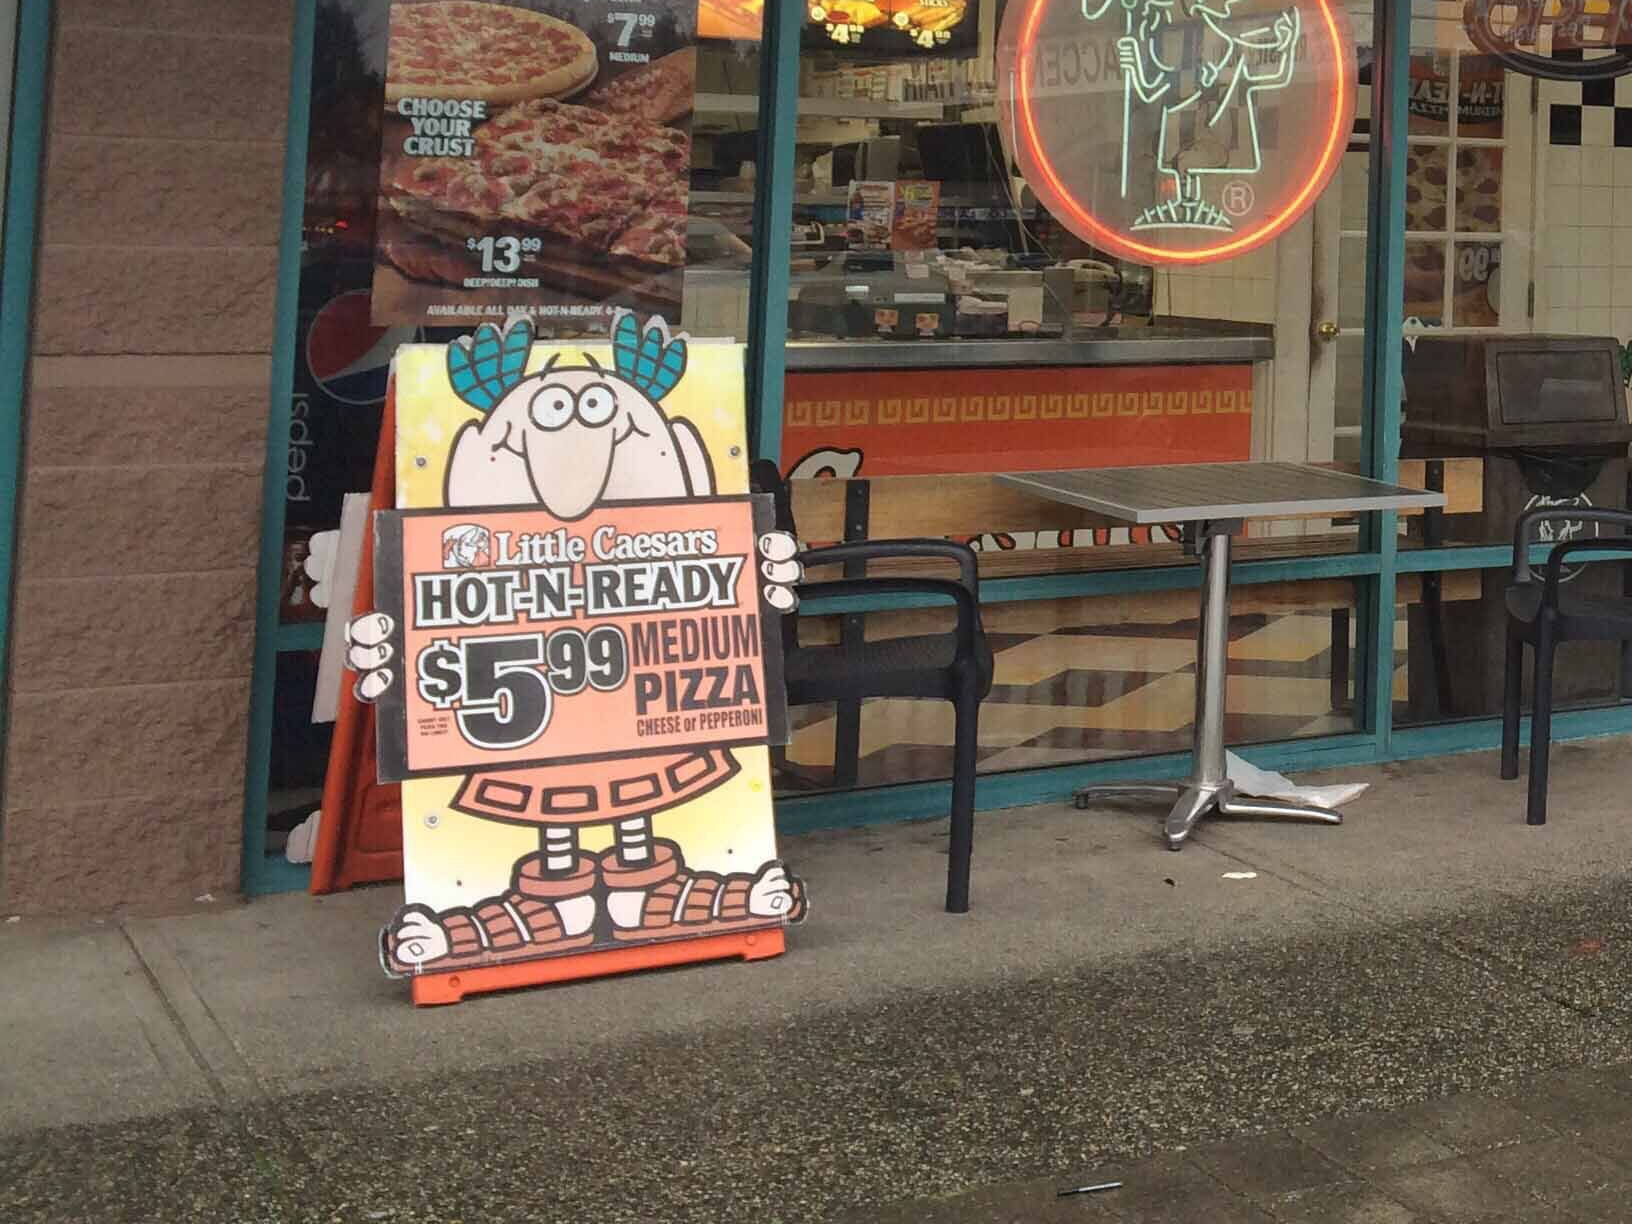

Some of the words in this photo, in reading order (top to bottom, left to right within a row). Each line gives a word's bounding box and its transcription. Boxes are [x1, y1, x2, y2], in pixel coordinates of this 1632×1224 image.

[608, 51, 650, 64] MEDIUM
[397, 97, 488, 120] CHOOSE
[410, 117, 472, 138] YOUR
[403, 136, 476, 157] CRUST
[287, 394, 313, 502] pepsi
[495, 527, 586, 566] Little
[591, 525, 718, 561] Caesars
[414, 555, 746, 628] HOT-N-READY
[631, 614, 760, 667] MEDIUM
[634, 663, 761, 716] PIZZA
[636, 717, 683, 738] CHEESE
[684, 717, 697, 733] or
[699, 708, 764, 730] PEPPERONI
